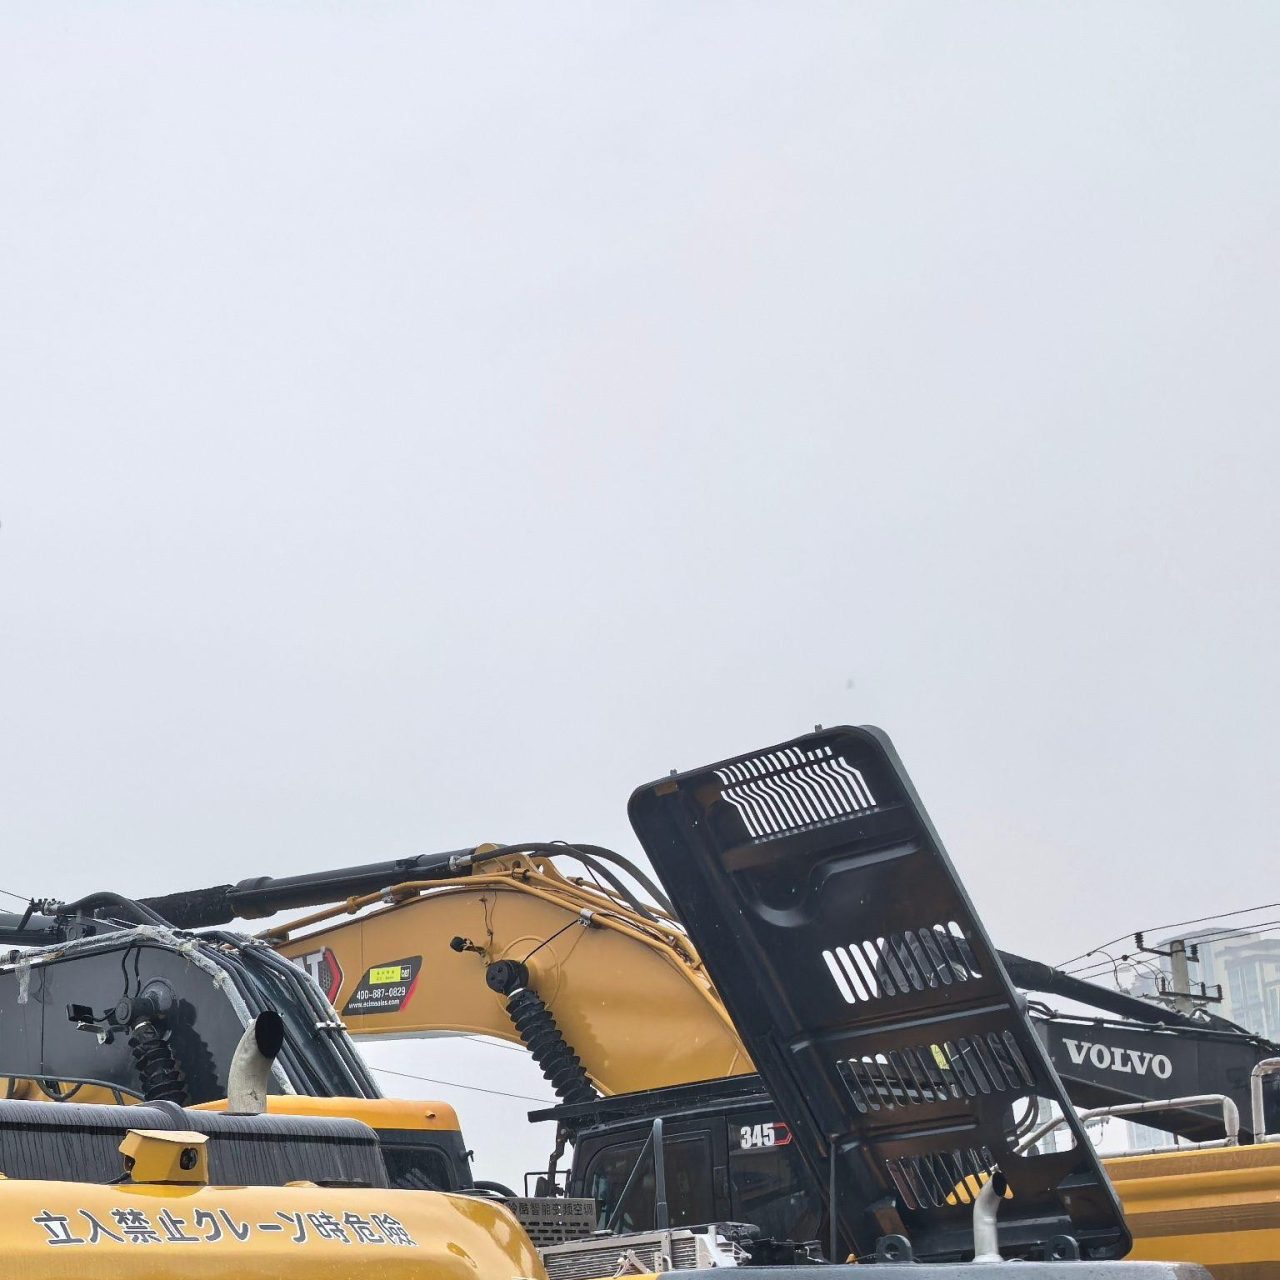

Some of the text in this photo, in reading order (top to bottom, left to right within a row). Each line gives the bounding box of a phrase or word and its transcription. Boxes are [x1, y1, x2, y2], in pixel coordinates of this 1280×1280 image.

[356, 986, 406, 1000] 400-887-0829
[1062, 1038, 1173, 1079] VOLVO
[740, 1122, 775, 1149] 345
